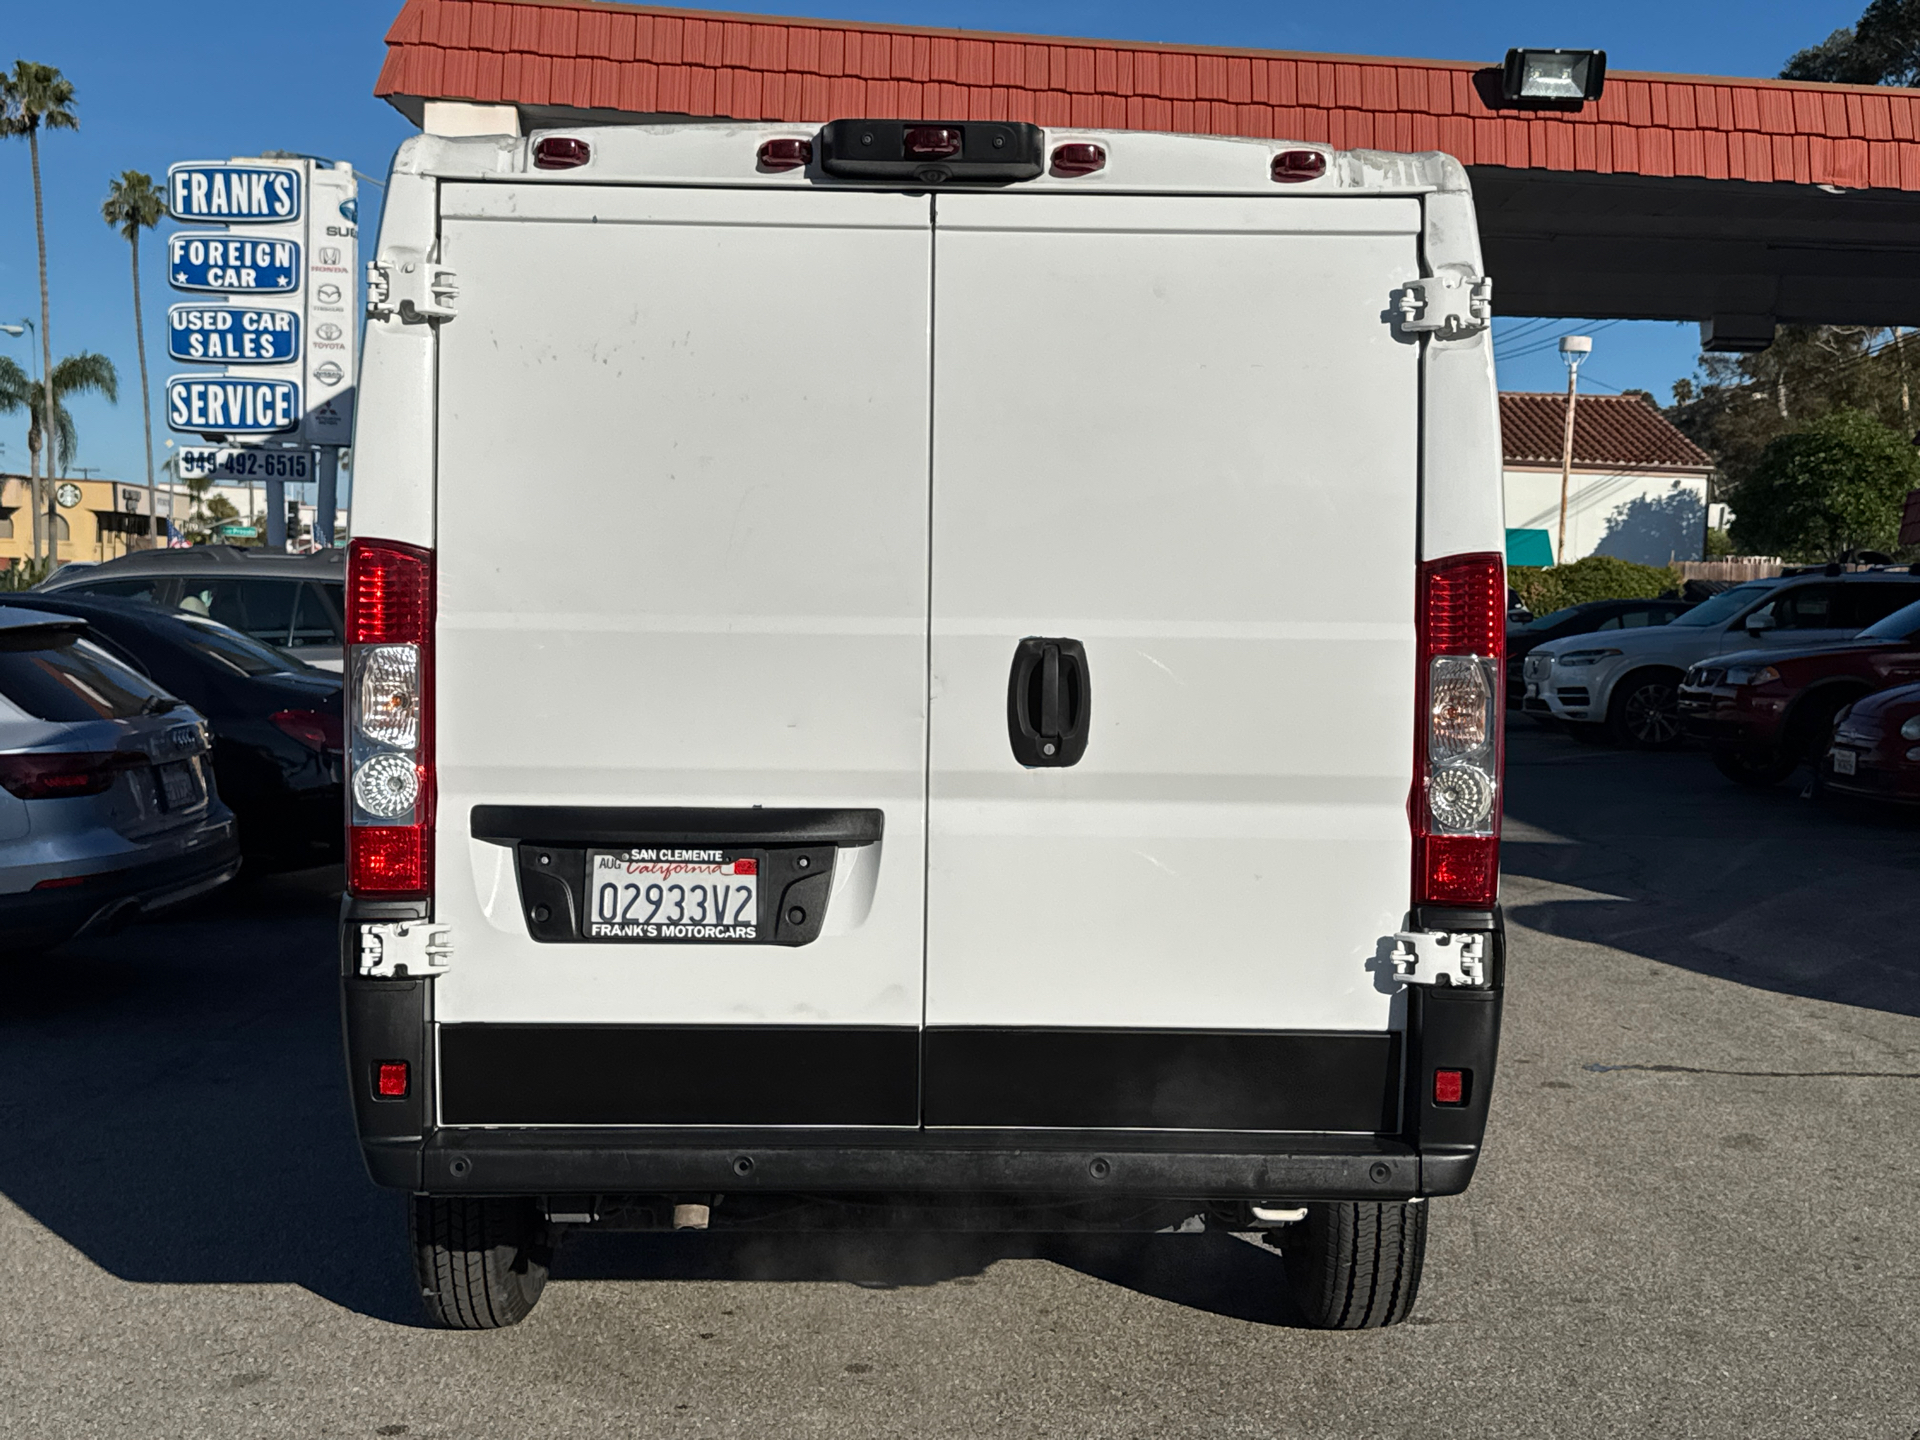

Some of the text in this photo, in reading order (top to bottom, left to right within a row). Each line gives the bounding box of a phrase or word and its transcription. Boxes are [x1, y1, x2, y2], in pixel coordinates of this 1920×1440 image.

[174, 172, 291, 215] FRANK'S
[173, 240, 290, 268] FOREIGN
[207, 268, 257, 288] CAR
[172, 311, 290, 332] USED CAR
[189, 333, 275, 358] SALES
[313, 342, 345, 350] TOYOTA
[171, 384, 290, 426] SERVICE
[182, 451, 306, 477] 949-492-6515
[599, 857, 622, 870] AUG
[631, 849, 723, 862] SAN CLEMENTE
[626, 862, 728, 881] California
[598, 882, 753, 924] 02933V2
[592, 924, 757, 939] FRANK'S MOTORCARS
